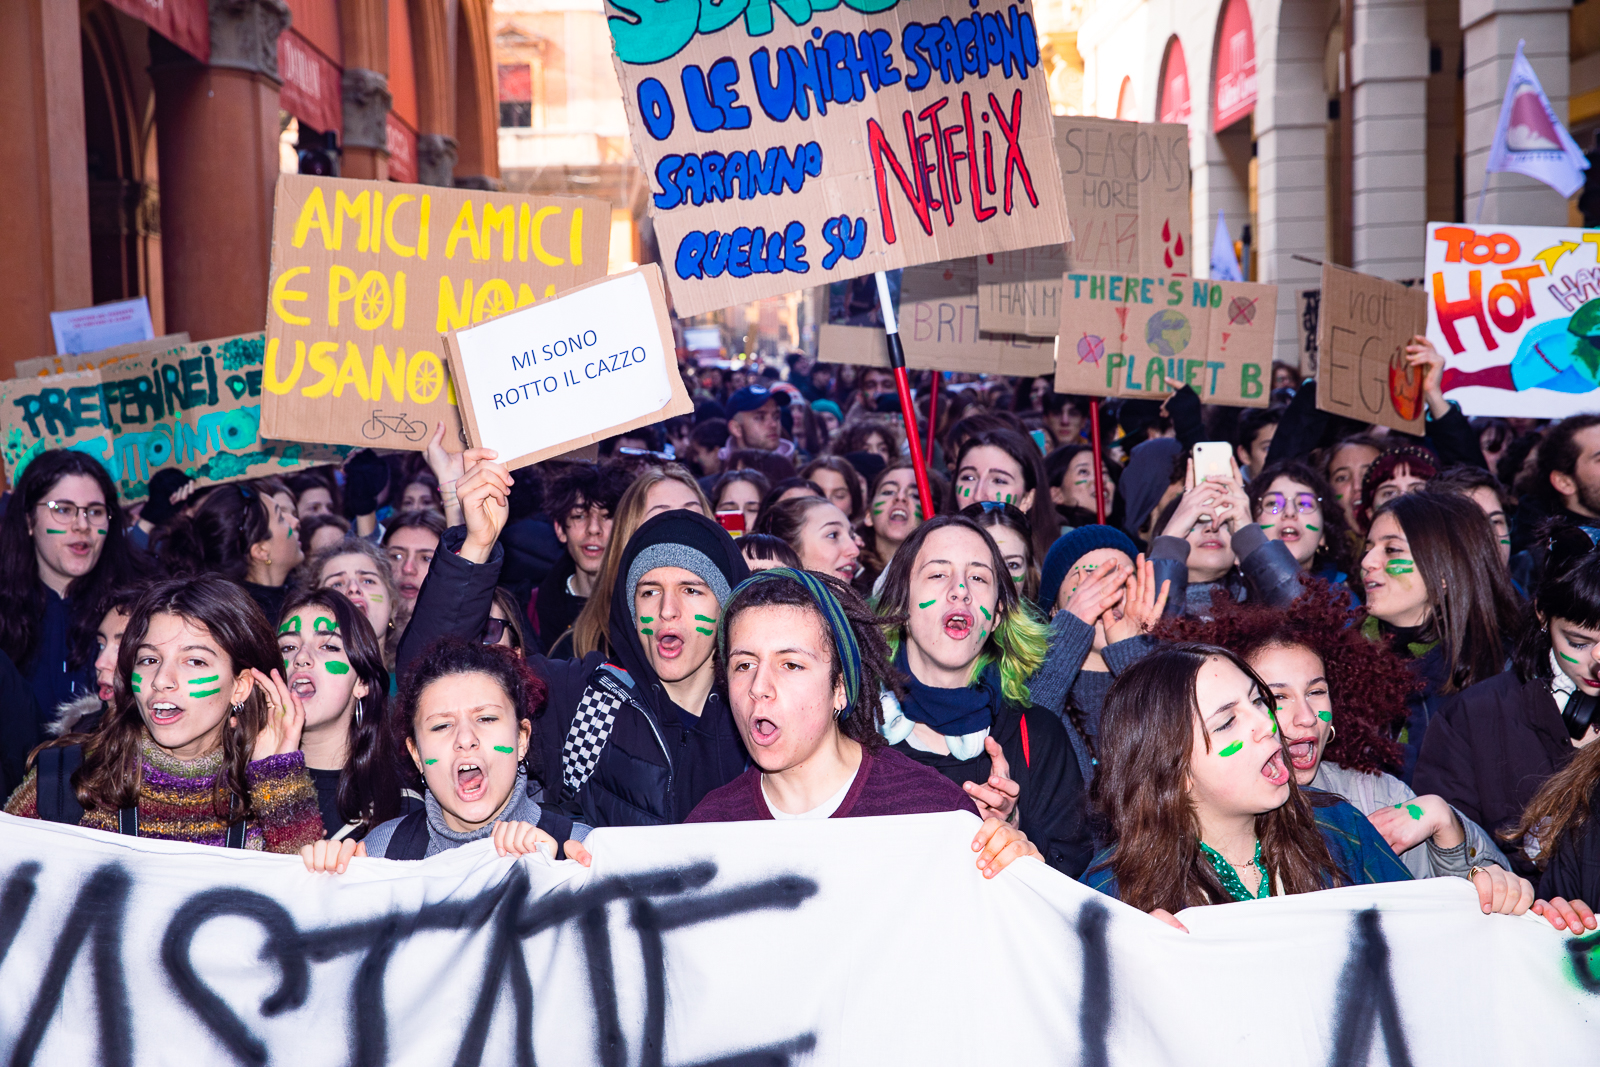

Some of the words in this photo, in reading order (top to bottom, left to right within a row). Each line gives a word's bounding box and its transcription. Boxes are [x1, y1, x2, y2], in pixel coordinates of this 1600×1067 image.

[636, 77, 675, 141] O
[680, 56, 752, 133] LE
[653, 140, 823, 209] SARANNO
[1065, 126, 1188, 192] SEASONS
[292, 186, 431, 261] AMICI
[445, 199, 584, 267] AMICI
[675, 220, 810, 281] QUELLE
[821, 214, 868, 270] SU
[1434, 226, 1521, 265] TOO
[272, 266, 311, 326] E
[328, 264, 407, 331] POI
[986, 281, 1037, 316] THAN
[1068, 274, 1184, 306] THERE'S
[1192, 282, 1223, 309] NO
[1432, 264, 1546, 355] HOT
[264, 337, 444, 405] USANO
[493, 375, 559, 410] ROTTO
[563, 370, 580, 388] IL
[583, 345, 647, 380] CAZZO
[511, 348, 537, 372] MI
[544, 329, 598, 362] SONO
[1240, 363, 1264, 399] B
